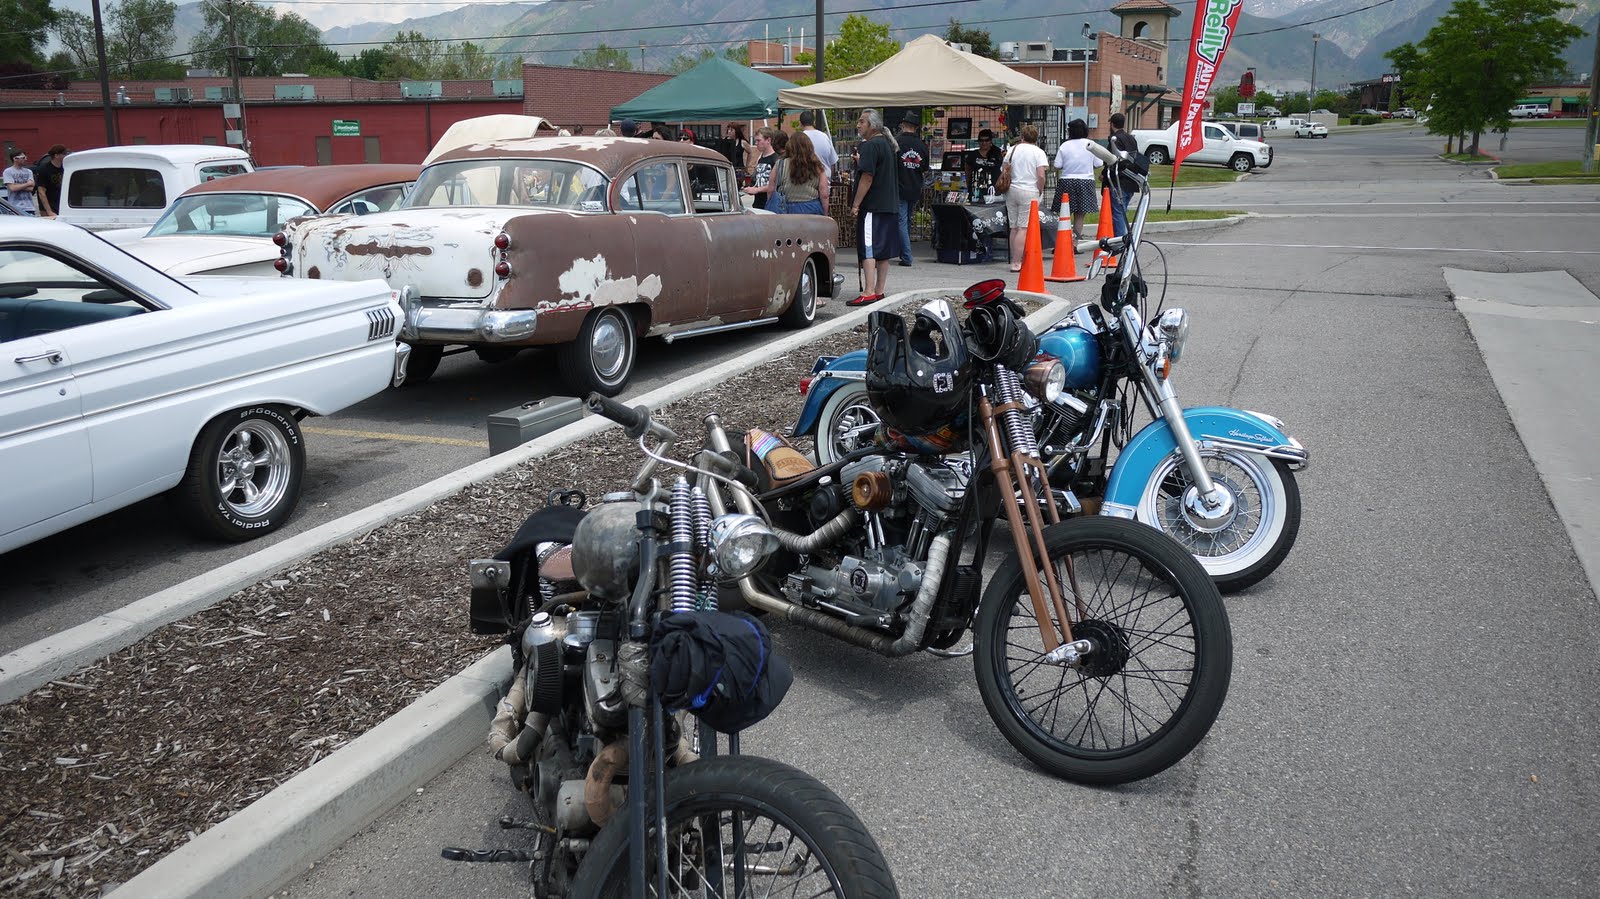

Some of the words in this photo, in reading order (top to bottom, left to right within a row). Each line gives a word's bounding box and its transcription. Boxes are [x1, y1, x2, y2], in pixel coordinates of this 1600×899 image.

[1200, 0, 1232, 59] Reilly
[1195, 62, 1214, 100] AUTO
[1181, 103, 1201, 147] PARTS
[240, 407, 298, 445] BFGoodrich
[218, 502, 230, 520] T/A
[231, 518, 270, 529] Radial
